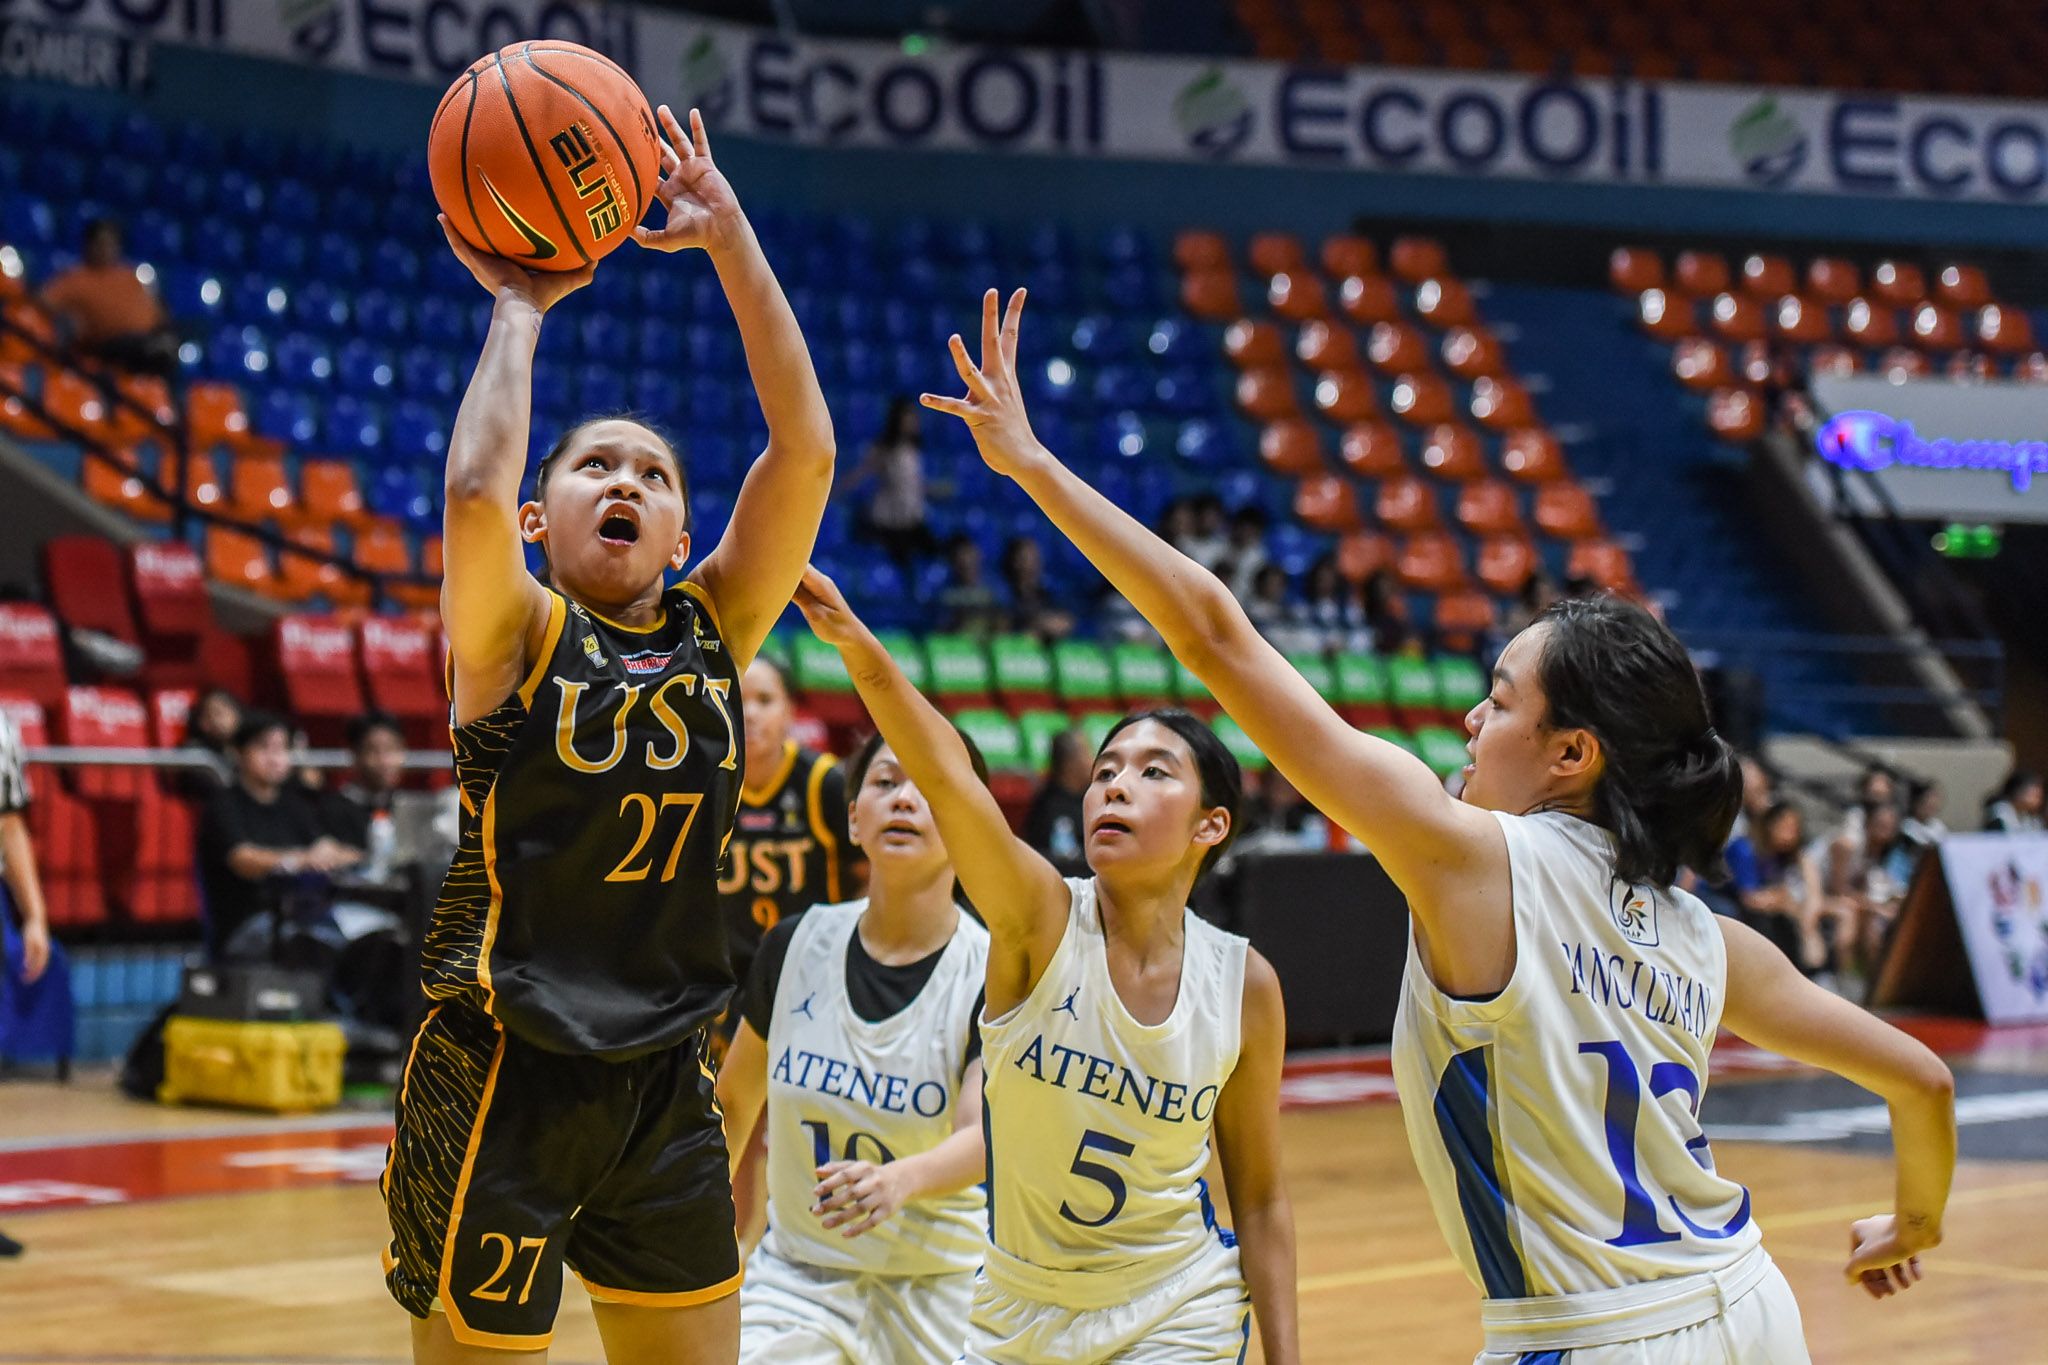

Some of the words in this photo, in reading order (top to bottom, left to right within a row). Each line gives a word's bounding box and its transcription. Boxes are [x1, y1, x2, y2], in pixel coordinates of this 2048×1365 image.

[747, 38, 1103, 145] EcoOil
[1277, 68, 1664, 178] EcoOil
[548, 123, 622, 241] ELITE
[553, 673, 737, 774] UST
[604, 793, 704, 882] 27
[772, 1045, 947, 1118] ATENEO
[1014, 1034, 1218, 1123] ATENEO
[1059, 1129, 1136, 1227] 5
[1578, 1040, 1750, 1247] 13
[470, 1233, 547, 1304] 27
